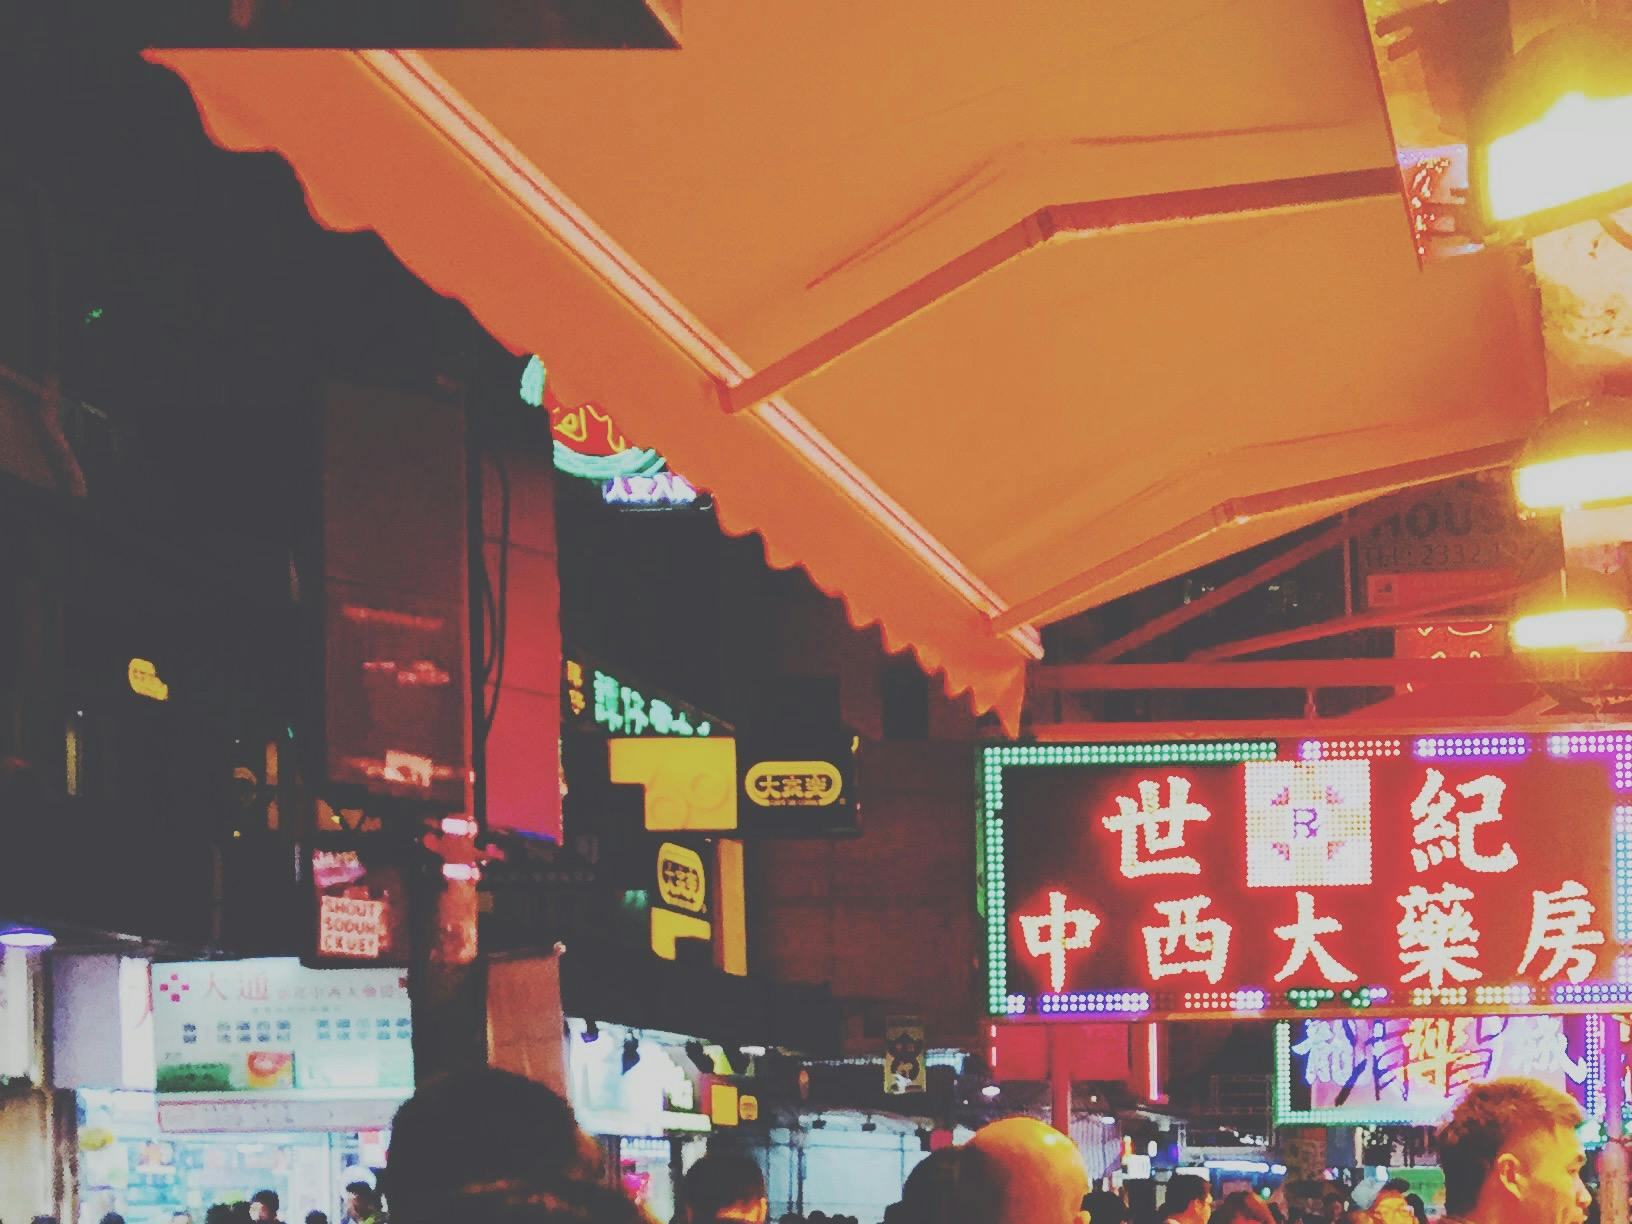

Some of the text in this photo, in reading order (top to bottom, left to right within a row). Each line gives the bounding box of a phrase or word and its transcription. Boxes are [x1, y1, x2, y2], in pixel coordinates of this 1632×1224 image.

[1019, 881, 1606, 992] 中西大藥房
